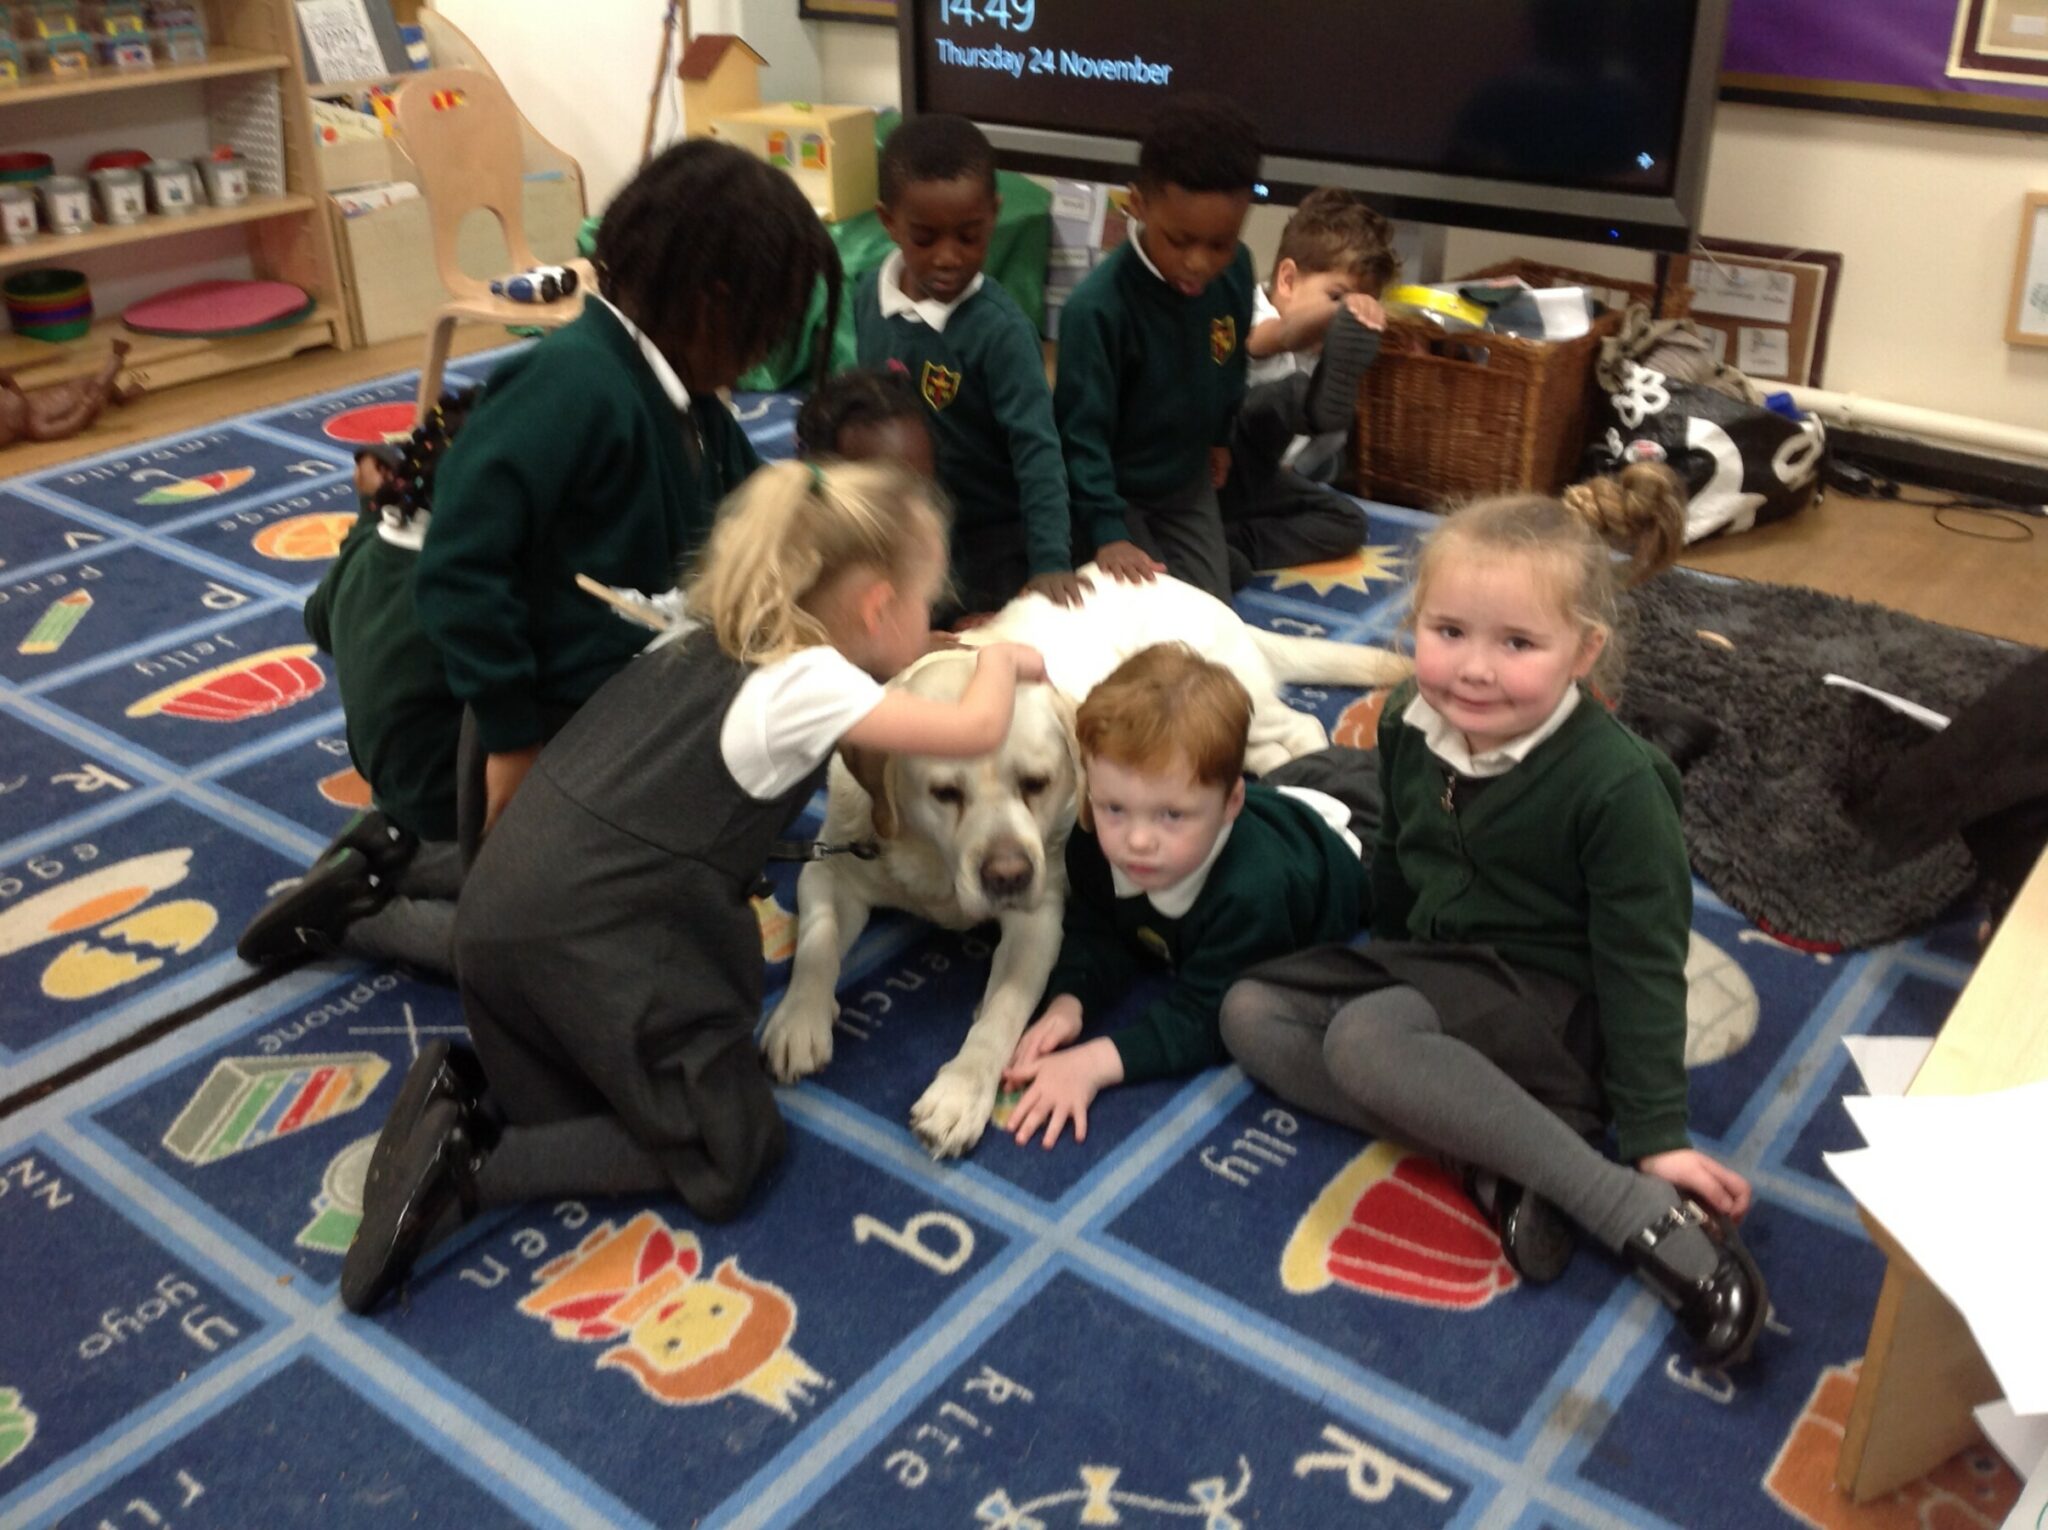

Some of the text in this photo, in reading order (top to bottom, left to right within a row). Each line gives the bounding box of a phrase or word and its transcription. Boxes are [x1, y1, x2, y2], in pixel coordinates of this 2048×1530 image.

[935, 37, 1173, 86] Thursday 24 November
[217, 482, 353, 532] orange
[200, 580, 250, 610] p
[51, 763, 132, 792] k
[257, 972, 398, 1053] ophone
[1201, 1107, 1298, 1186] elly
[459, 1200, 590, 1289] een
[852, 1210, 975, 1276] q
[78, 1272, 199, 1360] yoyo
[180, 1304, 238, 1352] y
[885, 1364, 1035, 1488] kite
[1294, 1423, 1454, 1502] k
